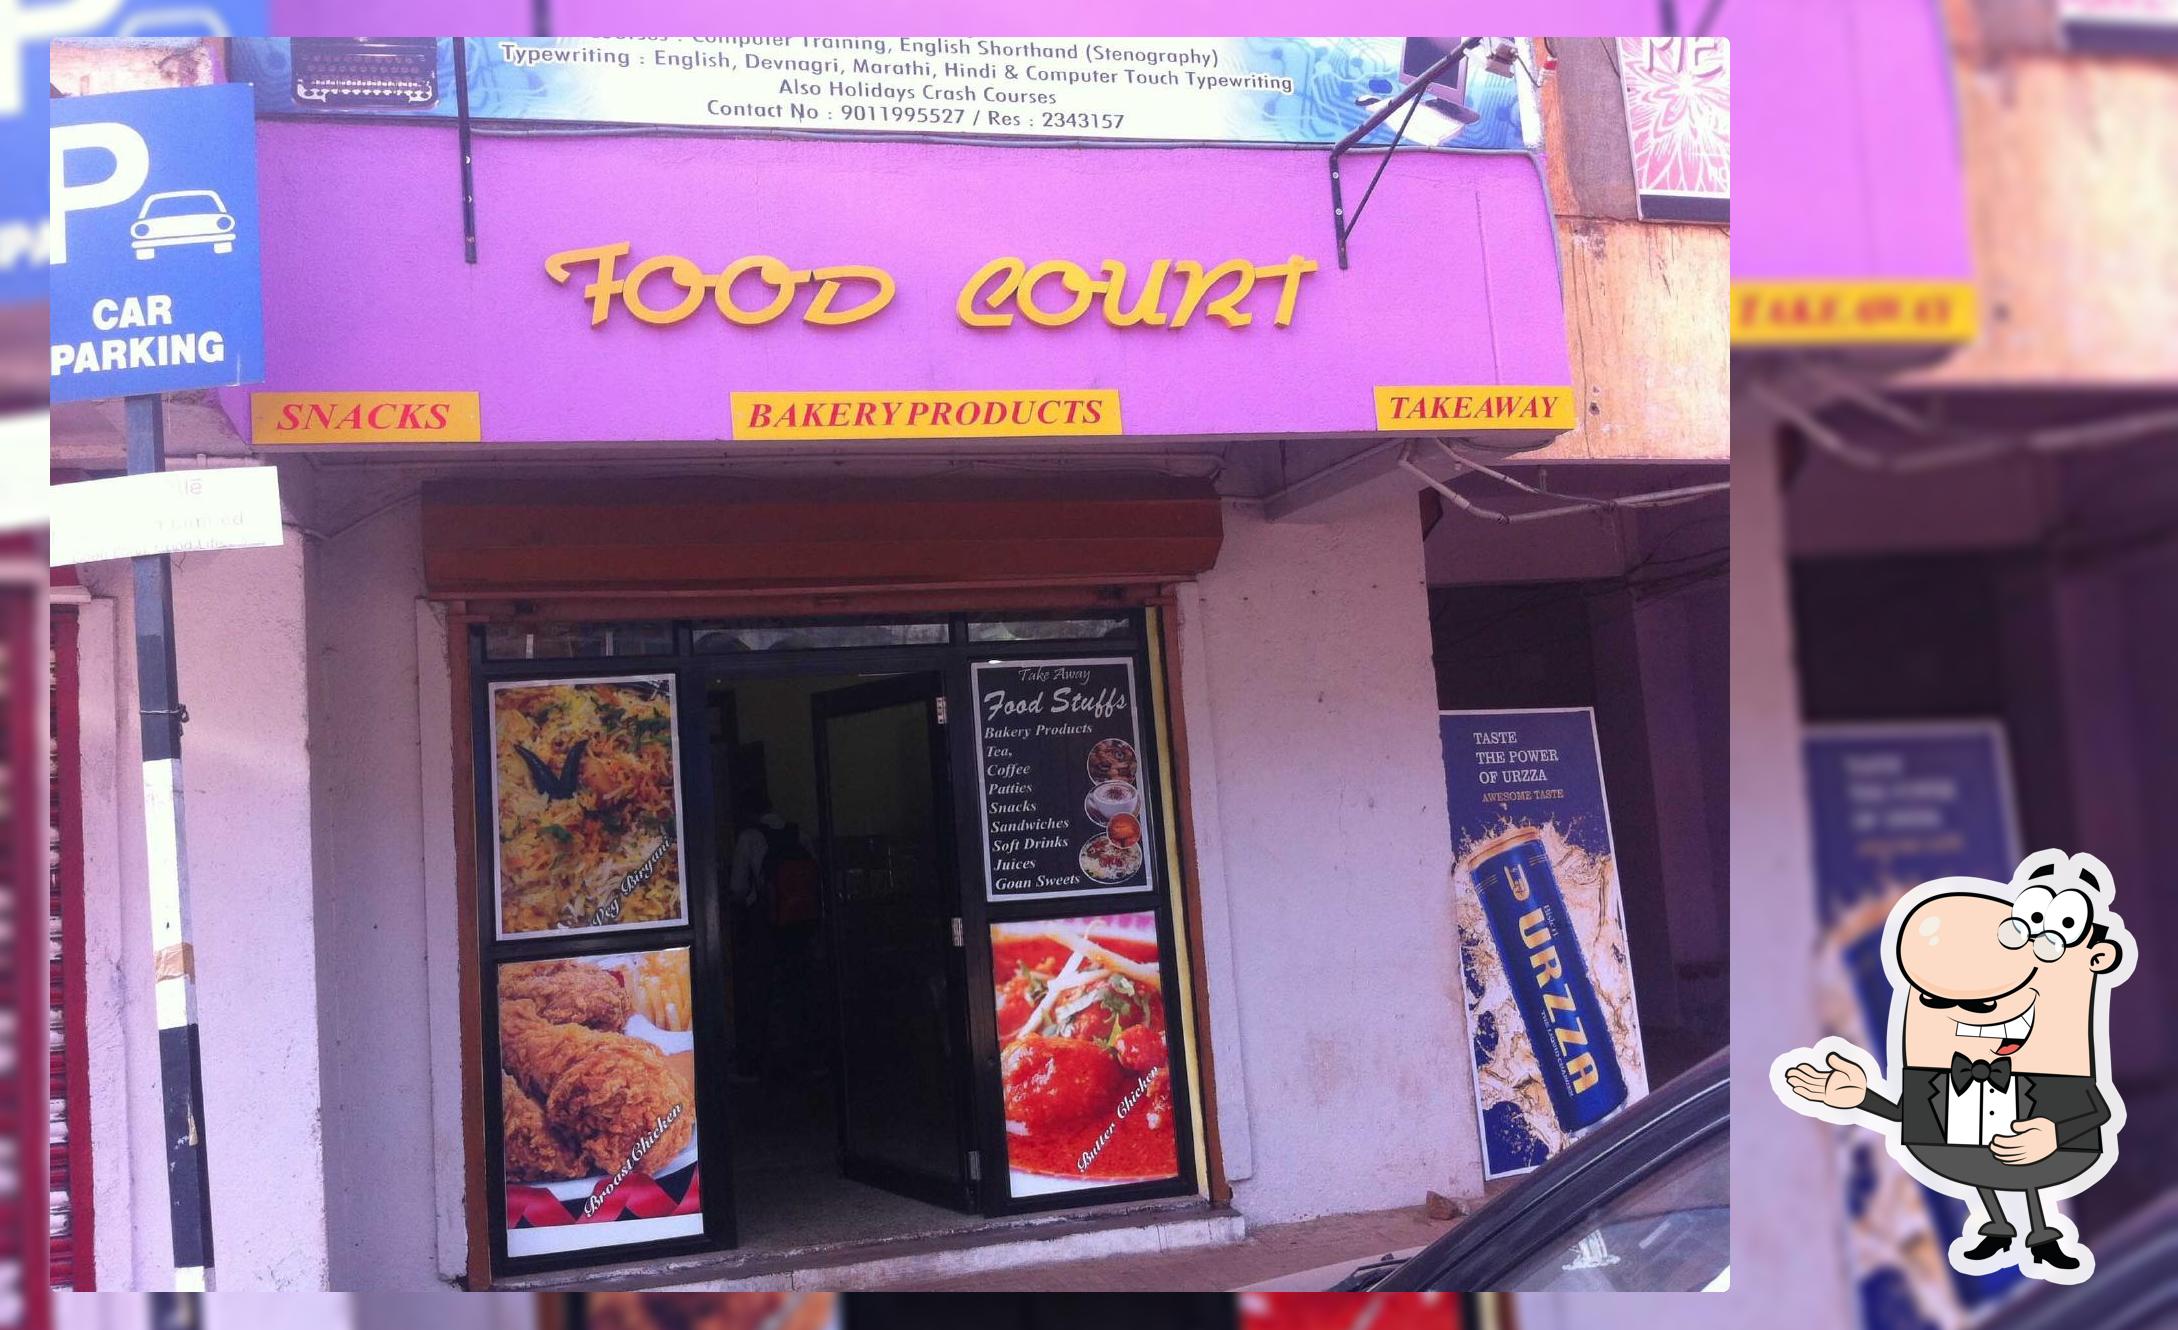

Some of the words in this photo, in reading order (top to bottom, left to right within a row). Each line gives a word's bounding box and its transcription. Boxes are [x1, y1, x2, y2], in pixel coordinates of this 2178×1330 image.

[901, 37, 970, 56] English
[978, 40, 1078, 59] Shorthand
[1086, 44, 1218, 68] (Stenography)
[501, 44, 630, 68] Typewriting
[655, 49, 737, 71] English,
[745, 53, 845, 76] Devnagri,
[853, 58, 937, 79] Marathi,
[945, 62, 996, 79] Hindi
[1004, 64, 1019, 80] &
[1026, 65, 1118, 85] Computer
[1124, 69, 1179, 85] Touch
[1185, 71, 1292, 93] Typewriting
[779, 78, 821, 96] Also
[830, 81, 915, 102] Holidays
[923, 84, 976, 102] Crash
[983, 86, 1057, 105] Courses
[707, 99, 784, 118] Contact
[791, 102, 819, 119] No
[841, 104, 965, 124] 9011995527
[988, 110, 1021, 126] Res
[1042, 112, 1125, 129] 2343157
[50, 122, 149, 265] P
[544, 240, 896, 328] FOOD
[956, 254, 1319, 330] COURT
[92, 294, 173, 331] CAR
[50, 331, 225, 376] PARKING
[276, 403, 450, 431] SNACKS
[1390, 396, 1559, 419] TAKEAWAY
[1018, 667, 1050, 683] Take
[1053, 668, 1091, 685] Away
[984, 690, 1044, 721] Food
[1050, 687, 1128, 718] Stuffs
[984, 726, 1031, 740] Bakery
[1036, 723, 1093, 737] Products
[1473, 731, 1517, 745] TASTE
[1475, 751, 1506, 765] THE
[1509, 749, 1559, 764] POWER
[987, 763, 1031, 778] Coffee
[1479, 771, 1498, 784] OF
[1502, 769, 1548, 783] URZZA
[988, 782, 1033, 795] Patties
[1482, 790, 1531, 802] AWESOME
[1534, 788, 1564, 800] TASTE
[989, 800, 1037, 814] Snacks
[991, 817, 1070, 833] Sandwiches
[992, 839, 1021, 854] Soft
[1024, 836, 1069, 850] Drinks
[621, 836, 671, 896] Biryani
[993, 858, 1036, 871] Juices
[995, 877, 1031, 891] Goan
[1036, 874, 1080, 888] Sweets
[1518, 907, 1599, 1095] URZZA
[1077, 1121, 1116, 1172] Butter
[1117, 1066, 1158, 1119] Chicken
[631, 1103, 682, 1162] Chicken
